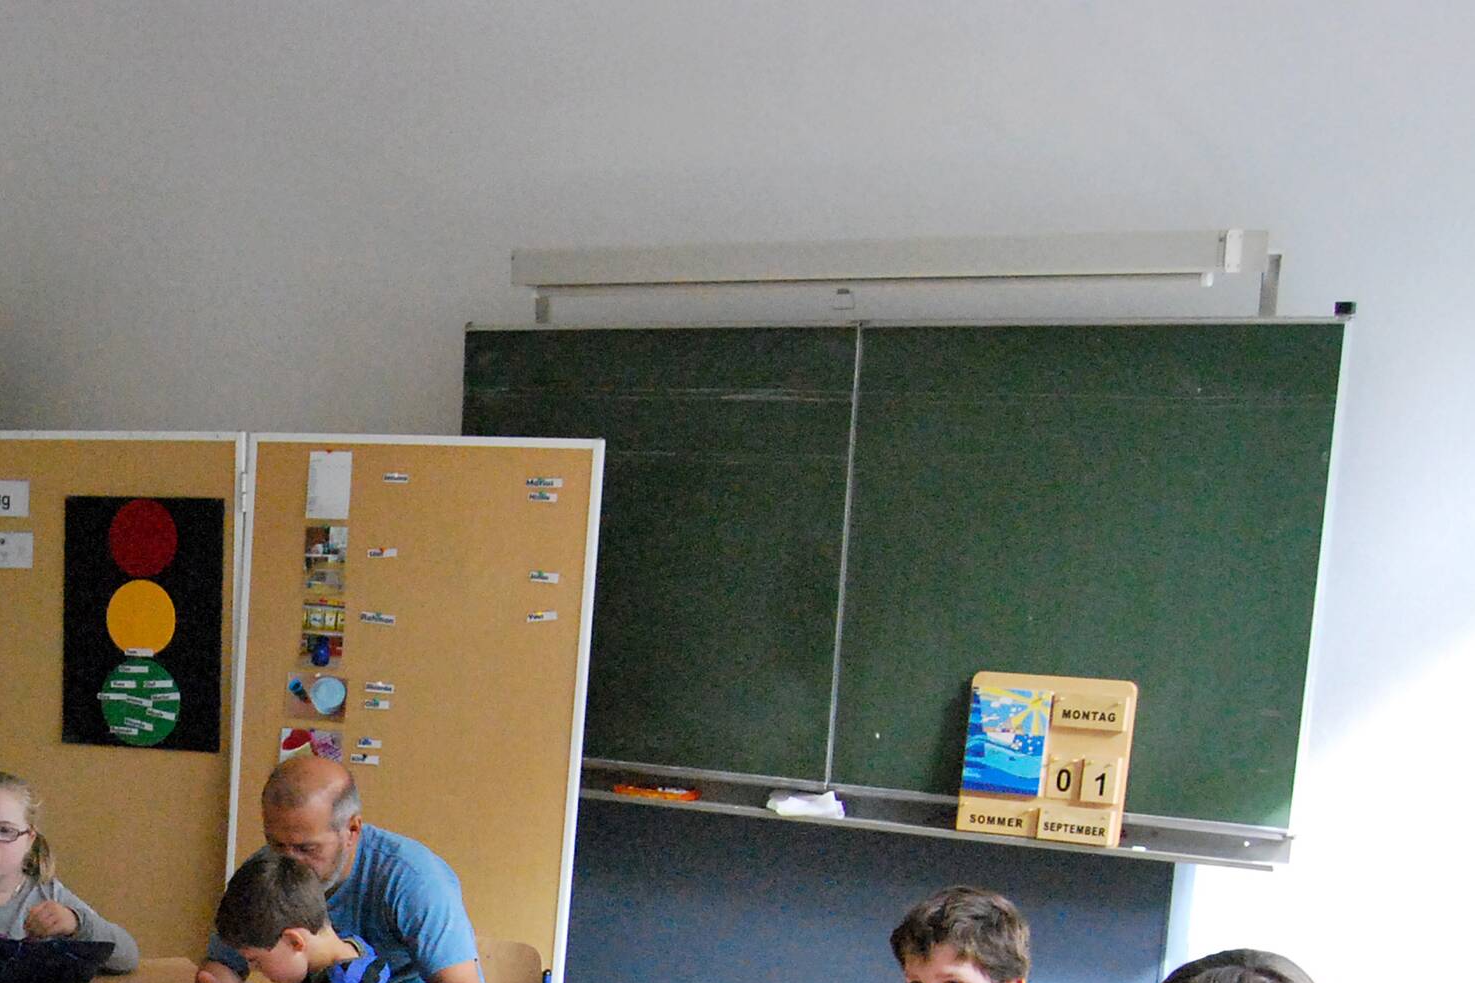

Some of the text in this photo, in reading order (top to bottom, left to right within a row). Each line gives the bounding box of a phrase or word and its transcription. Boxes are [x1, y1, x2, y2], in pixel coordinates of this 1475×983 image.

[1061, 709, 1117, 723] MONTAG
[969, 813, 1023, 829] SOMMER
[1043, 821, 1106, 838] SEPTEMBER
